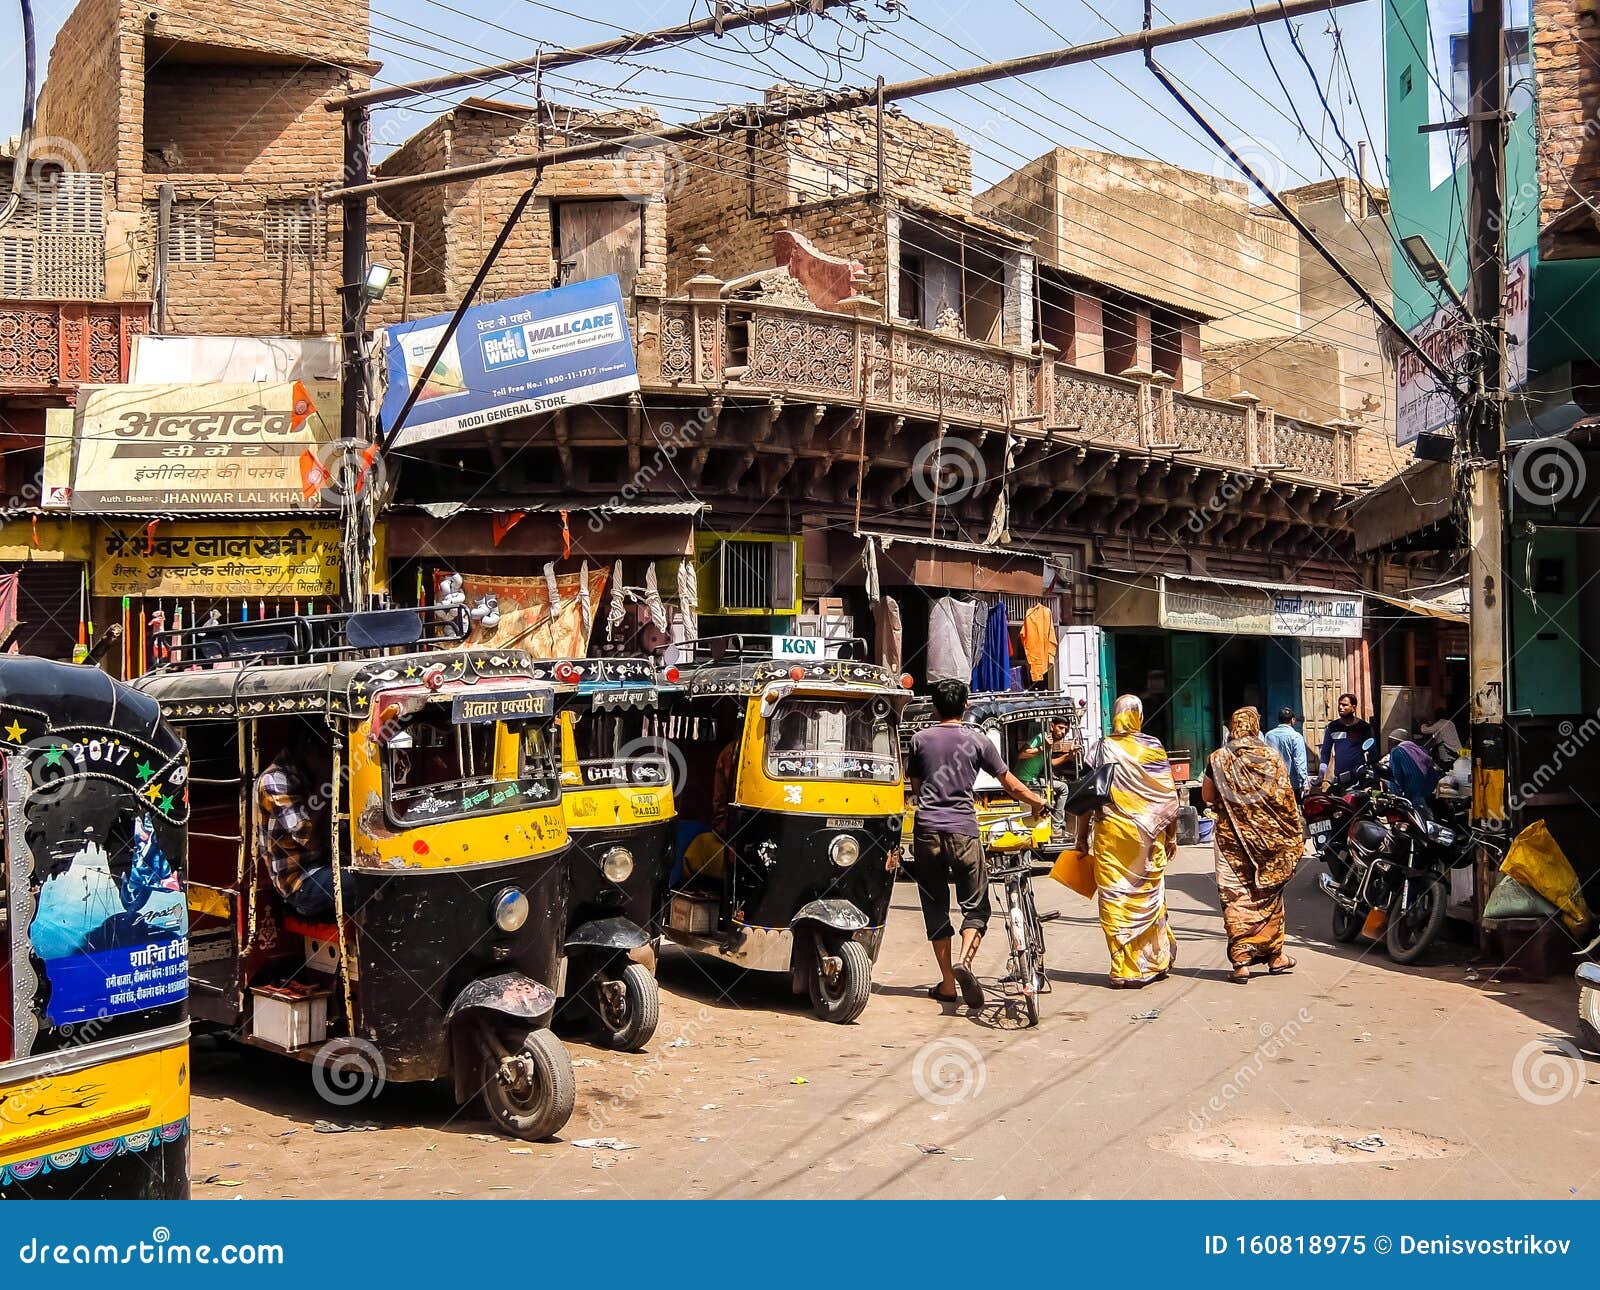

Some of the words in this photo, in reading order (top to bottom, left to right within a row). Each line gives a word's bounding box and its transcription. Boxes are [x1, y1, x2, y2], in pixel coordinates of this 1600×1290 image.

[498, 315, 507, 327] से
[510, 309, 532, 324] पहले
[528, 312, 614, 342] WALLCARE
[531, 347, 550, 356] White
[551, 340, 576, 351] Cement
[597, 331, 615, 341] Putty
[487, 346, 526, 365] White
[492, 386, 507, 397] Toll
[508, 383, 525, 394] Free
[544, 366, 597, 386] 1800-11-1717
[458, 414, 485, 429] MODI
[487, 404, 532, 422] GENERAL
[534, 395, 568, 410] STORE
[134, 463, 212, 482] इंजीनियर
[216, 463, 243, 480] की
[100, 495, 123, 503] Auth.
[161, 492, 234, 504] JHANWAR
[238, 492, 266, 503] LAL
[194, 536, 250, 558] लाल
[147, 561, 215, 580] अल्ट्राटेक
[781, 638, 816, 656] KGN
[501, 693, 545, 714] एक्सप्रेस
[72, 740, 130, 766] 2017
